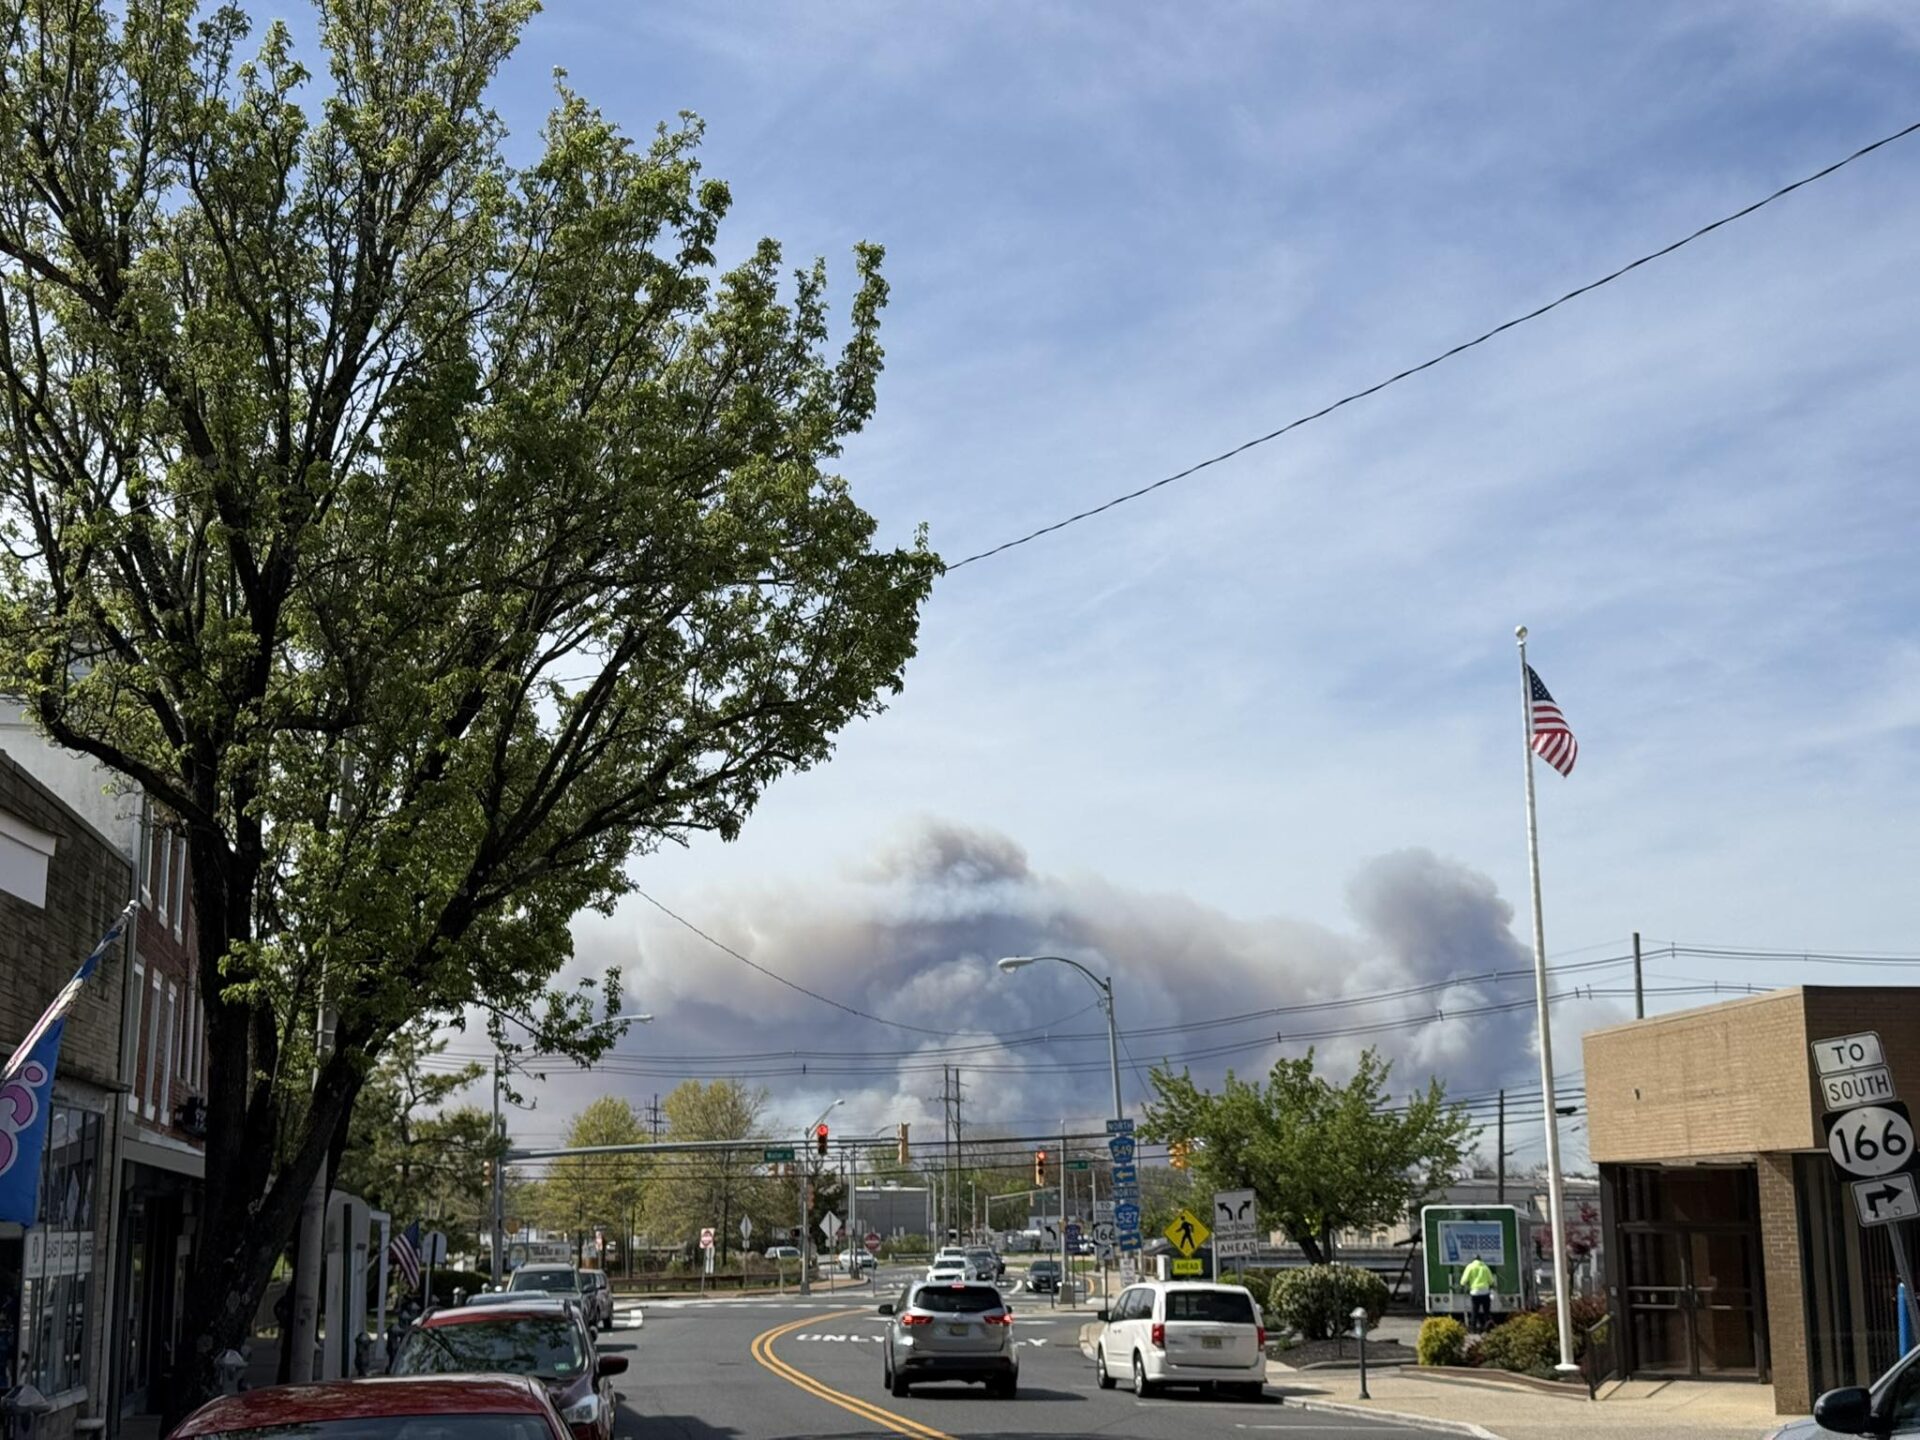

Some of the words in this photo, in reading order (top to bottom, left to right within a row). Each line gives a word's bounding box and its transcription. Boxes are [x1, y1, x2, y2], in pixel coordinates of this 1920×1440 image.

[1831, 1043, 1864, 1065] TO
[1829, 1074, 1889, 1102] SOUTH
[1107, 1121, 1132, 1131] NORTH
[1835, 1119, 1907, 1164] 166
[1118, 1211, 1138, 1223] 527
[1217, 1223, 1235, 1232] ONLY
[1236, 1222, 1255, 1231] ONLY
[1095, 1228, 1115, 1241] 166
[1221, 1241, 1257, 1253] AHEAD
[1176, 1262, 1199, 1270] AHEAD
[796, 1333, 886, 1342] ONLY
